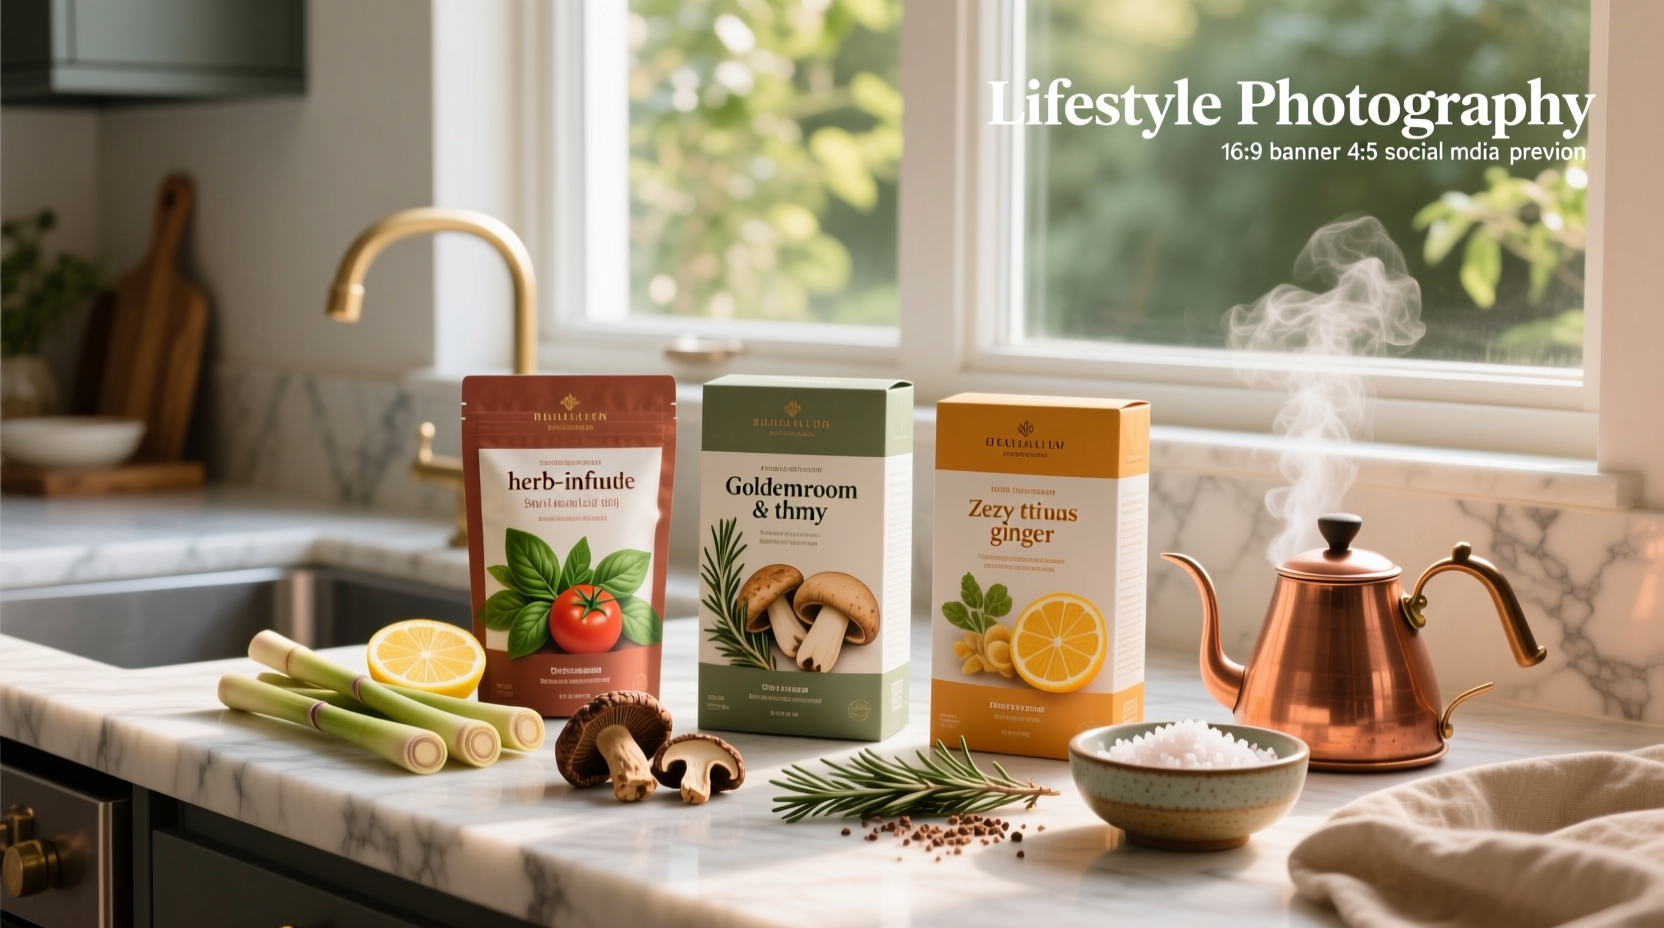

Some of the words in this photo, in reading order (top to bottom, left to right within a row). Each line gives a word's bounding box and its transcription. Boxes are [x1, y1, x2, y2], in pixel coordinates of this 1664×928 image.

[725, 476, 858, 499] Goldemroom
[752, 500, 769, 519] &
[774, 500, 828, 526] thmy
[968, 499, 1015, 526] Zezy
[990, 524, 1055, 548] ginger
